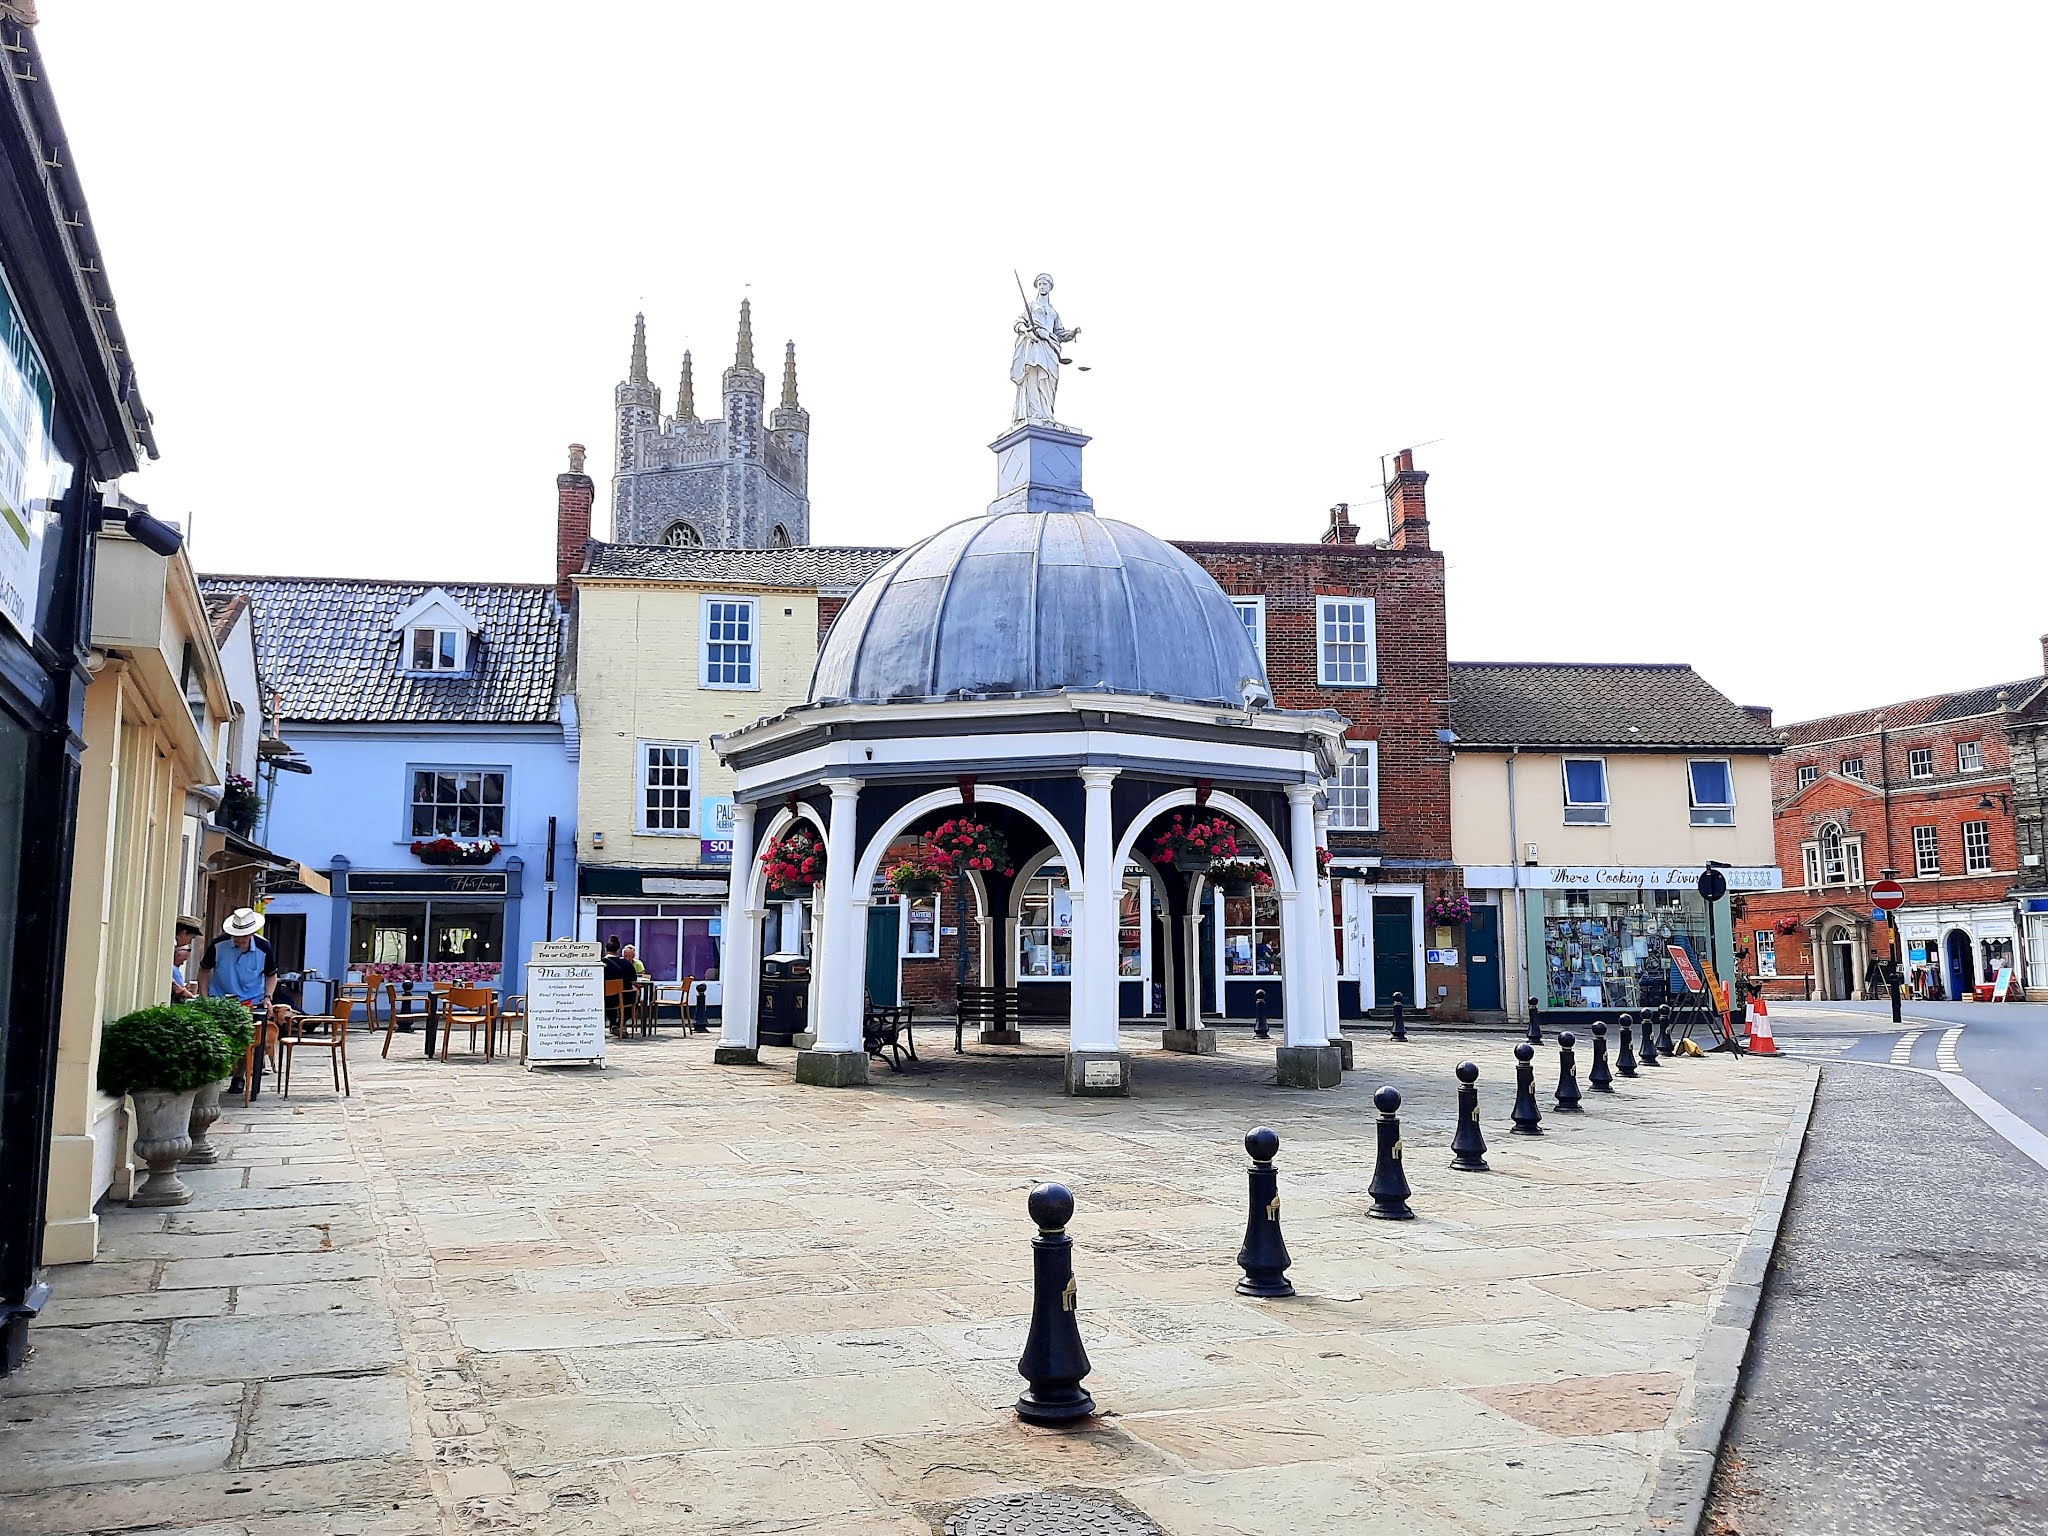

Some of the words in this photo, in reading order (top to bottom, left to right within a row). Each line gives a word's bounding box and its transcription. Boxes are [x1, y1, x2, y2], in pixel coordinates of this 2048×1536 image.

[9, 307, 21, 366] TO
[21, 339, 41, 396] LET
[716, 804, 735, 820] PAU
[710, 841, 734, 852] SOL
[1550, 868, 1590, 884] Where
[1596, 868, 1645, 888] Cooking
[1650, 871, 1660, 884] is
[1665, 869, 1701, 884] Livin
[537, 967, 560, 978] Ma
[565, 967, 593, 978] Belle
